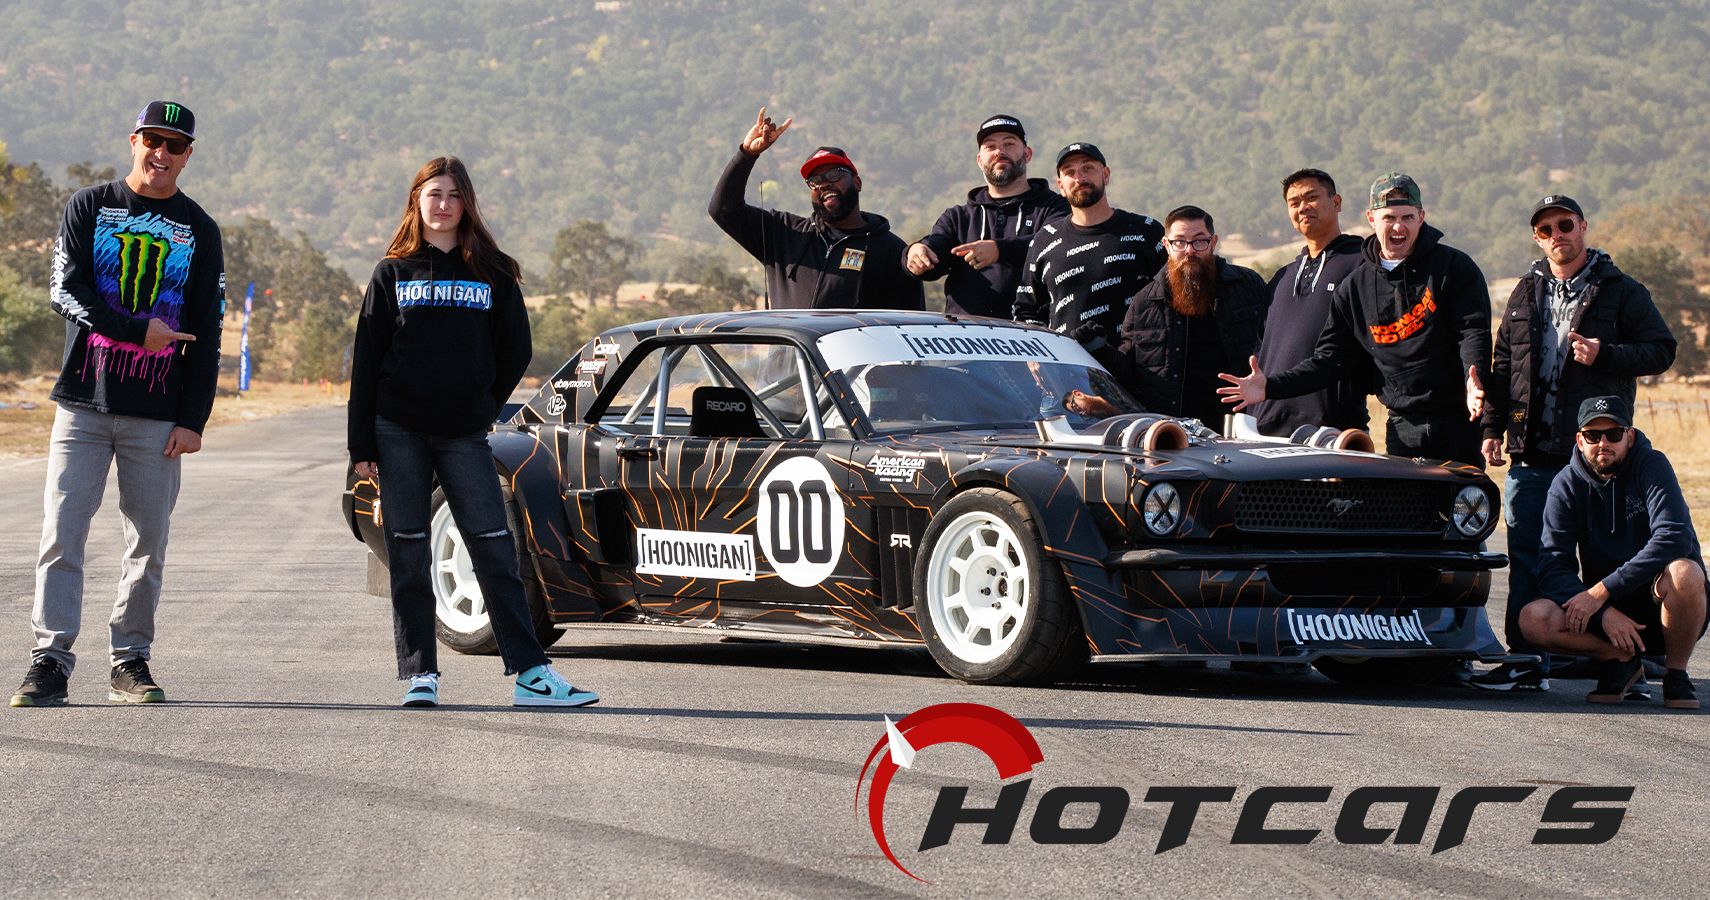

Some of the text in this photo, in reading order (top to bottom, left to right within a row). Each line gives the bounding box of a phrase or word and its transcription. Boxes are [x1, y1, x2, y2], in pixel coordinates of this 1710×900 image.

[1066, 241, 1100, 258] HOONIGAN
[1104, 253, 1136, 265] HOONIGAN
[1054, 265, 1085, 286] HOONIGAN
[1091, 276, 1122, 293] HOONIGAN
[1080, 304, 1110, 321] HOONIGAN
[706, 400, 747, 412] RECARO
[867, 453, 926, 469] American
[874, 466, 917, 483] Racing
[767, 480, 832, 564] 00
